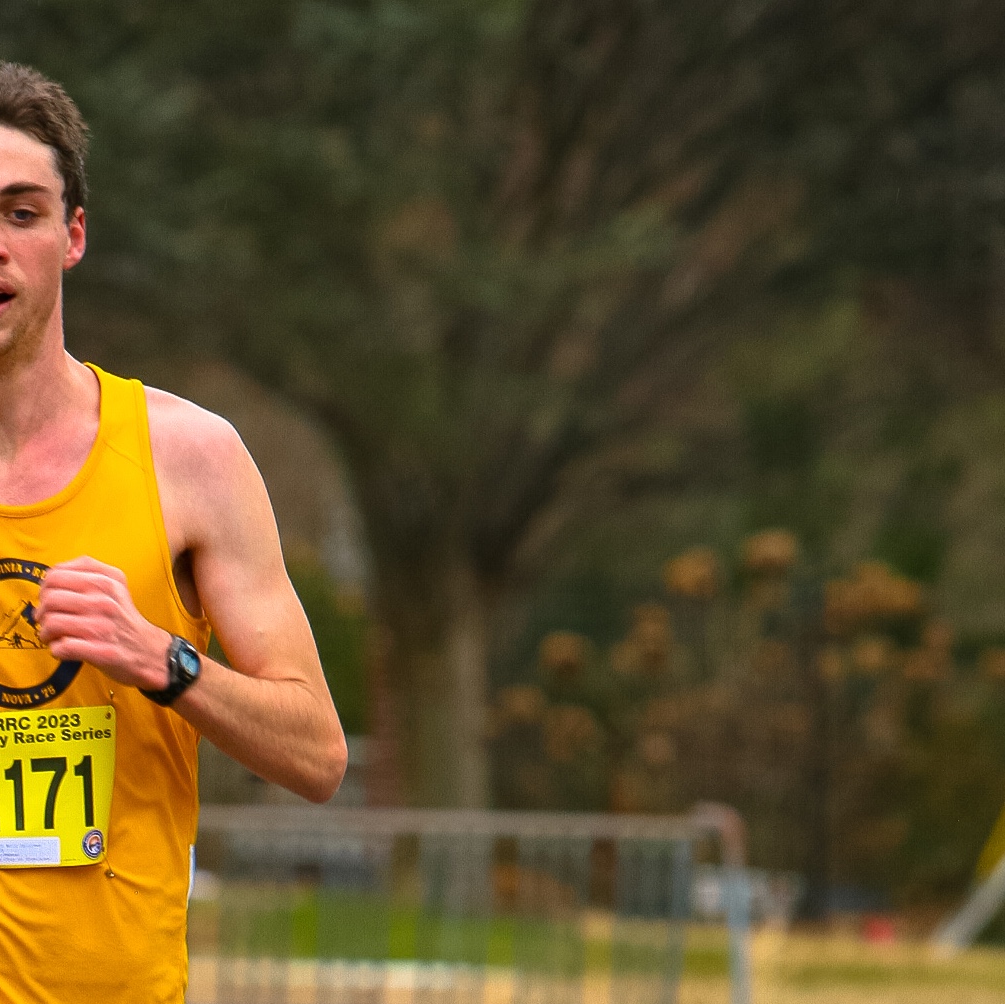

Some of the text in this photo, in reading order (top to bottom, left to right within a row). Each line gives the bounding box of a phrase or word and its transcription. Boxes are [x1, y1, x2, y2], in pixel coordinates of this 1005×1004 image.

[1, 692, 32, 704] NOVA
[37, 713, 81, 729] 2023
[14, 731, 56, 744] Race
[61, 727, 112, 741] Series
